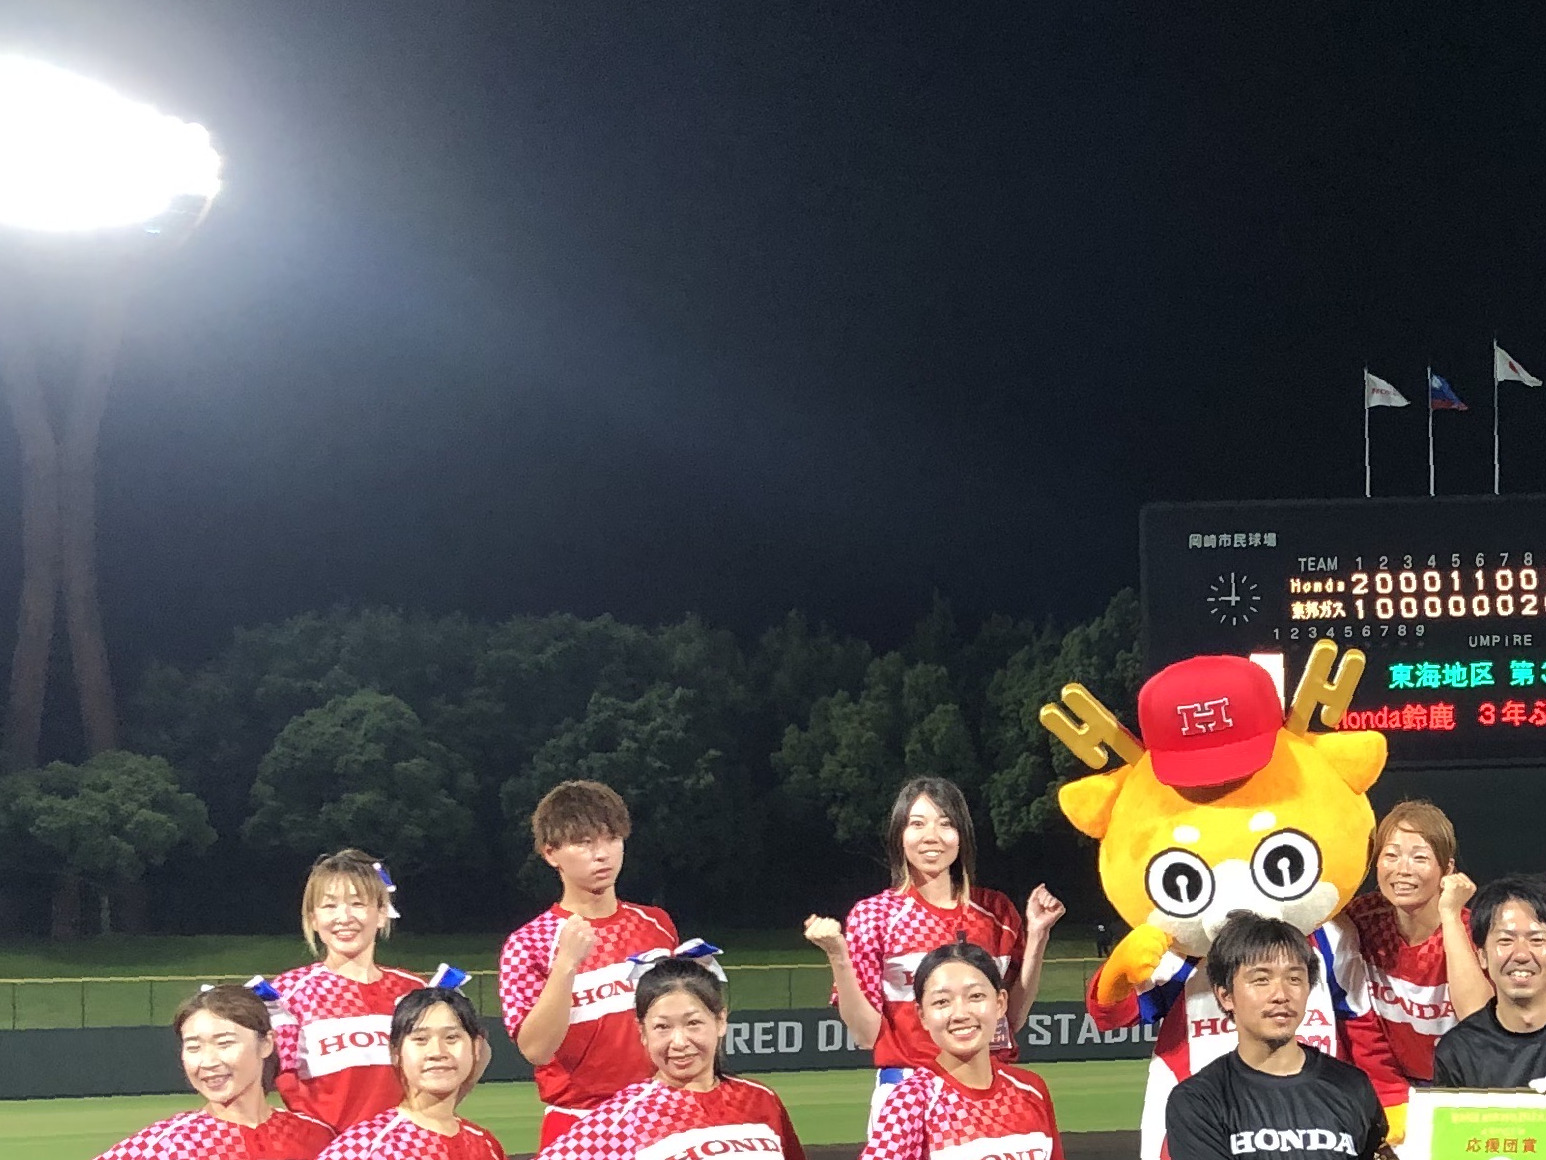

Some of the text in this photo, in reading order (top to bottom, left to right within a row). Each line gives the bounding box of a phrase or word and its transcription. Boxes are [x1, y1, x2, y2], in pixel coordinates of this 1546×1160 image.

[1297, 556, 1338, 572] TEAM
[1355, 556, 1362, 571] 1
[1379, 555, 1388, 570] 2
[1403, 554, 1413, 570] 3
[1427, 554, 1436, 568] 4
[1451, 553, 1461, 568] 5
[1475, 552, 1485, 568] 6
[1499, 552, 1509, 567] 7
[1523, 551, 1533, 567] 8
[1290, 577, 1345, 594] Honda
[1351, 573, 1369, 595] 2
[1375, 572, 1393, 594] 0
[1399, 571, 1417, 593] 0
[1423, 571, 1441, 592] 0
[1450, 570, 1460, 592] 1
[1475, 569, 1484, 591] 1
[1495, 568, 1514, 591] 0
[1519, 568, 1538, 590] 0
[1355, 598, 1364, 620] 1
[1376, 597, 1394, 619] 0
[1399, 596, 1418, 618] 0
[1424, 596, 1442, 618] 0
[1448, 595, 1466, 617] 0
[1472, 594, 1490, 617] 0
[1496, 594, 1514, 616] 0
[1520, 594, 1538, 616] 2
[1273, 624, 1425, 640] 1 2 3 4 5 6 7 8 9
[1468, 634, 1532, 648] UMPIRE
[1388, 661, 1495, 690] 東海地区
[1176, 697, 1234, 736] H
[572, 978, 638, 1008] HON
[318, 1031, 391, 1057] HON
[725, 1020, 804, 1055] RED
[1027, 1011, 1165, 1046] STADI
[1229, 1128, 1360, 1157] HONDA
[1465, 1137, 1538, 1154] 応援団賞
